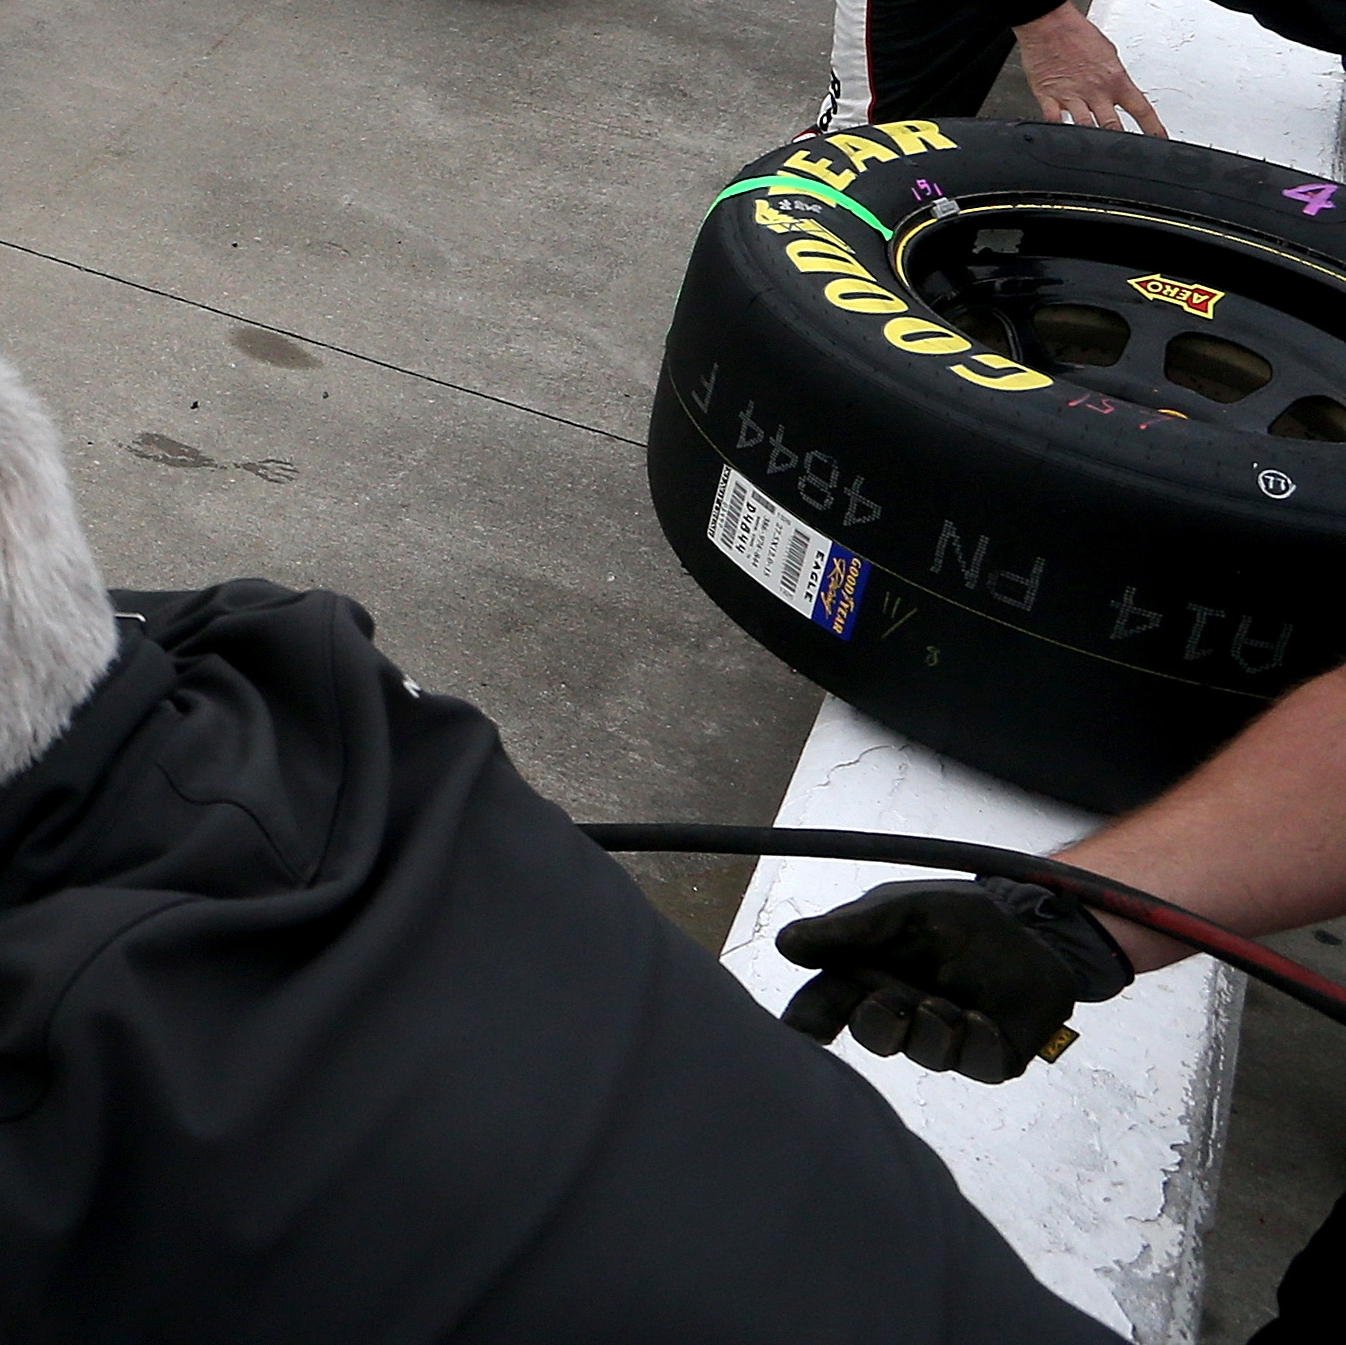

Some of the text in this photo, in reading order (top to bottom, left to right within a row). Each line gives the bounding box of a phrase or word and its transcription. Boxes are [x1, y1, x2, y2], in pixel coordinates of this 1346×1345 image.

[1145, 281, 1209, 309] AERO
[737, 400, 883, 528] 4844
[804, 551, 825, 604] EAGLE
[832, 556, 863, 635] GOODYEAR
[930, 518, 1046, 613] PN
[1109, 587, 1294, 674] A14
